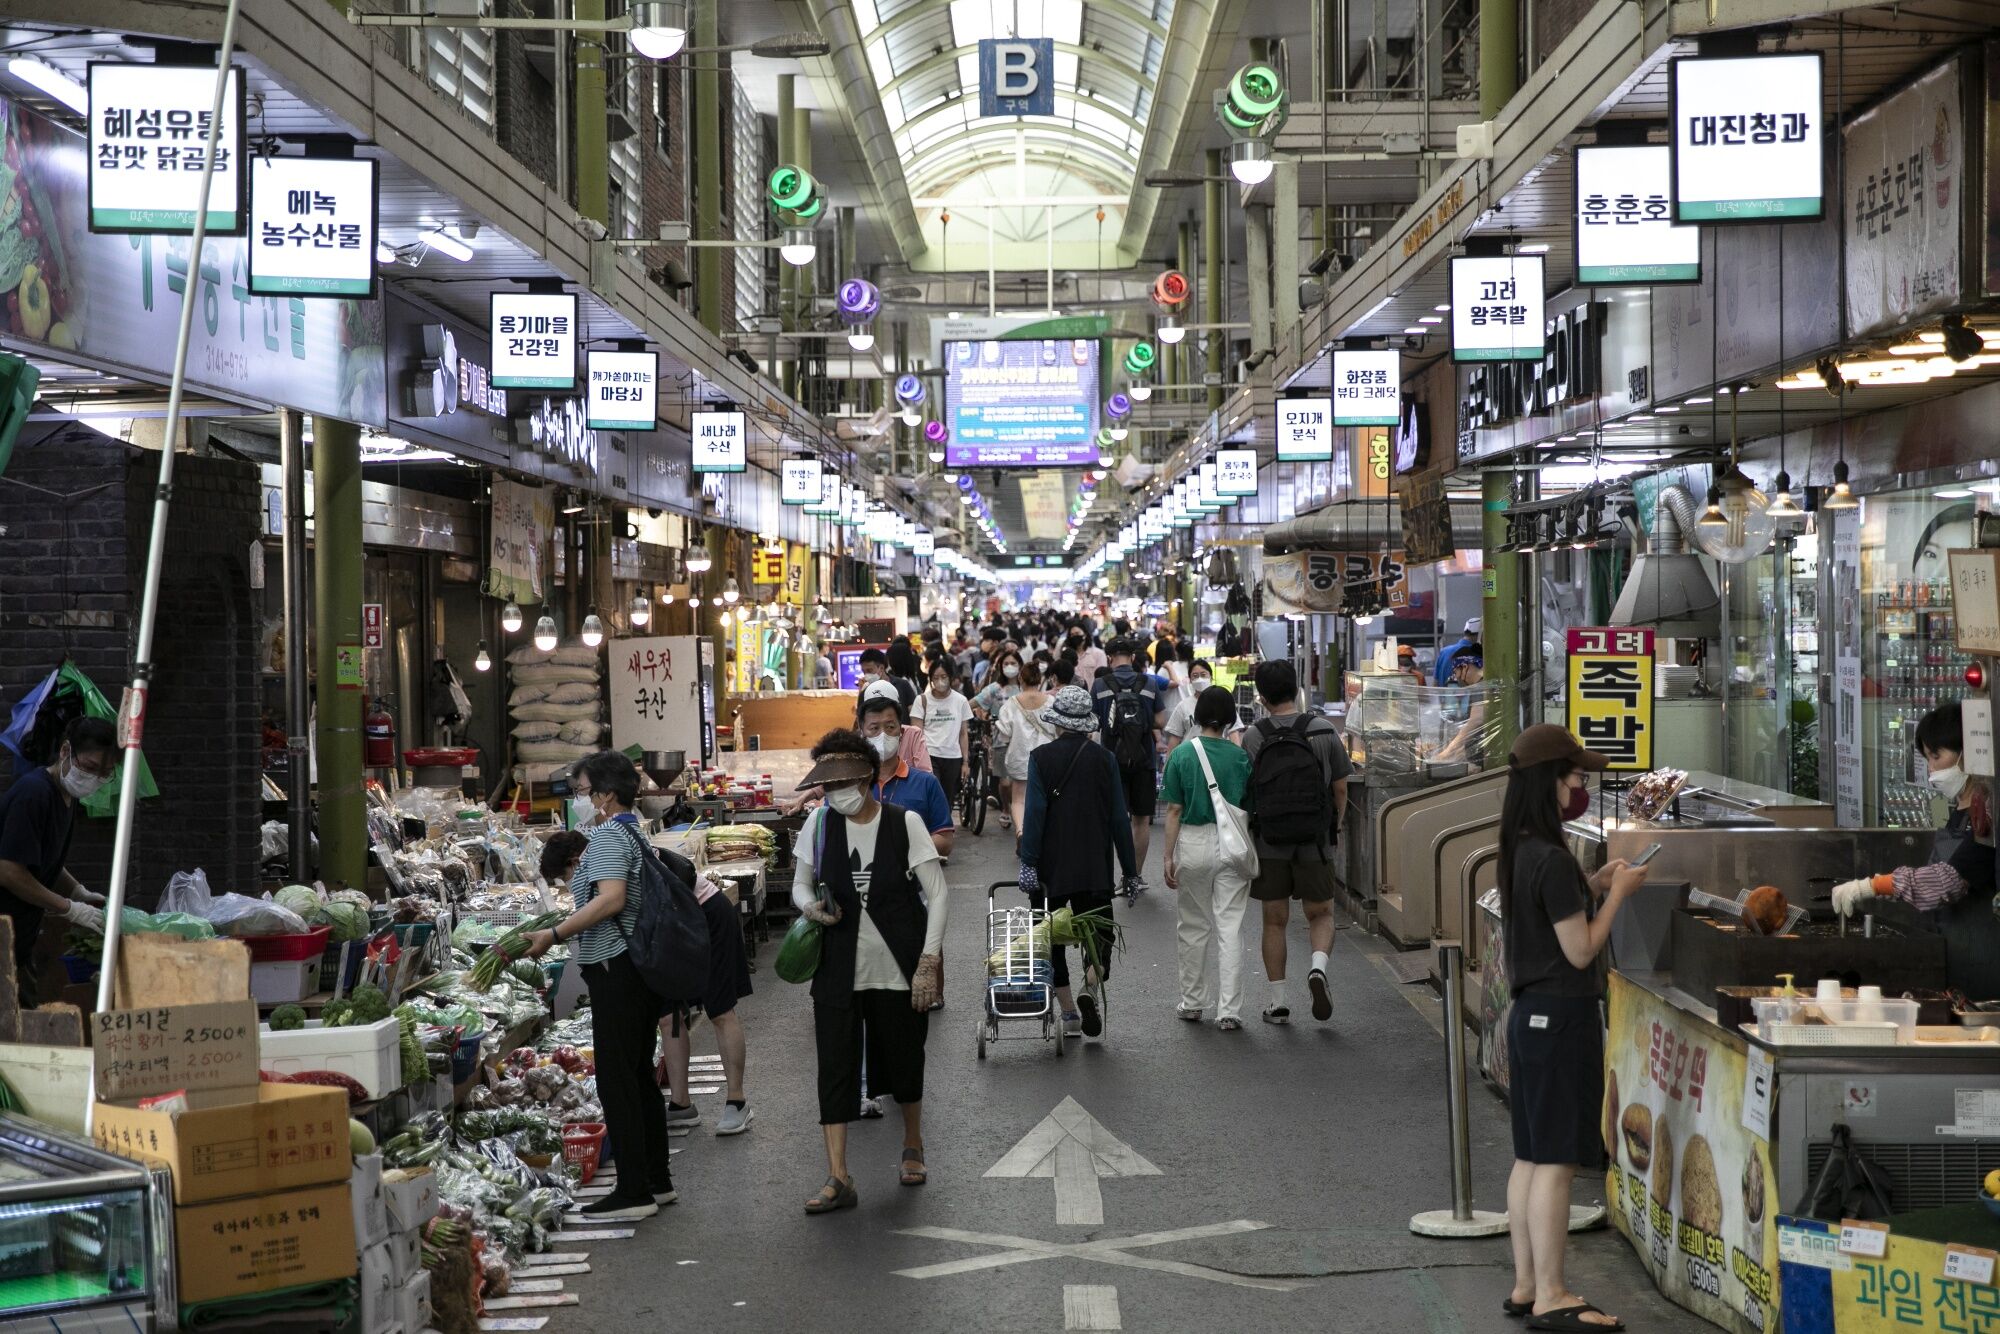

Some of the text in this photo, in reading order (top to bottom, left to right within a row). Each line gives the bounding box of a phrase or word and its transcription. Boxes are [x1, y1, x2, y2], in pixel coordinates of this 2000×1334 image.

[995, 44, 1039, 97] B
[1005, 99, 1029, 112] 구역
[103, 106, 226, 139] 혜성유통
[1690, 112, 1810, 147] 대진청과
[98, 145, 148, 172] 참맛
[288, 190, 337, 216] 에녹
[262, 221, 362, 249] 농수산물
[1480, 281, 1516, 300] 고려
[499, 315, 569, 335] 옹기마을
[1470, 306, 1527, 326] 왕족발
[509, 338, 559, 357] 건강원
[1346, 370, 1387, 384] 화장품
[601, 387, 643, 402] 마당쇠
[1338, 386, 1396, 399] 뷰티 크레딧
[701, 425, 737, 438] 새나래
[1292, 428, 1317, 441] 분식
[708, 440, 731, 453] 수산
[1576, 631, 1644, 655] 고려
[628, 648, 673, 683] 새우젓
[634, 687, 667, 720] 국산
[1578, 661, 1645, 764] 족발
[1650, 1019, 1708, 1114] 훈훈호떡
[1855, 1263, 1925, 1326] 과일
